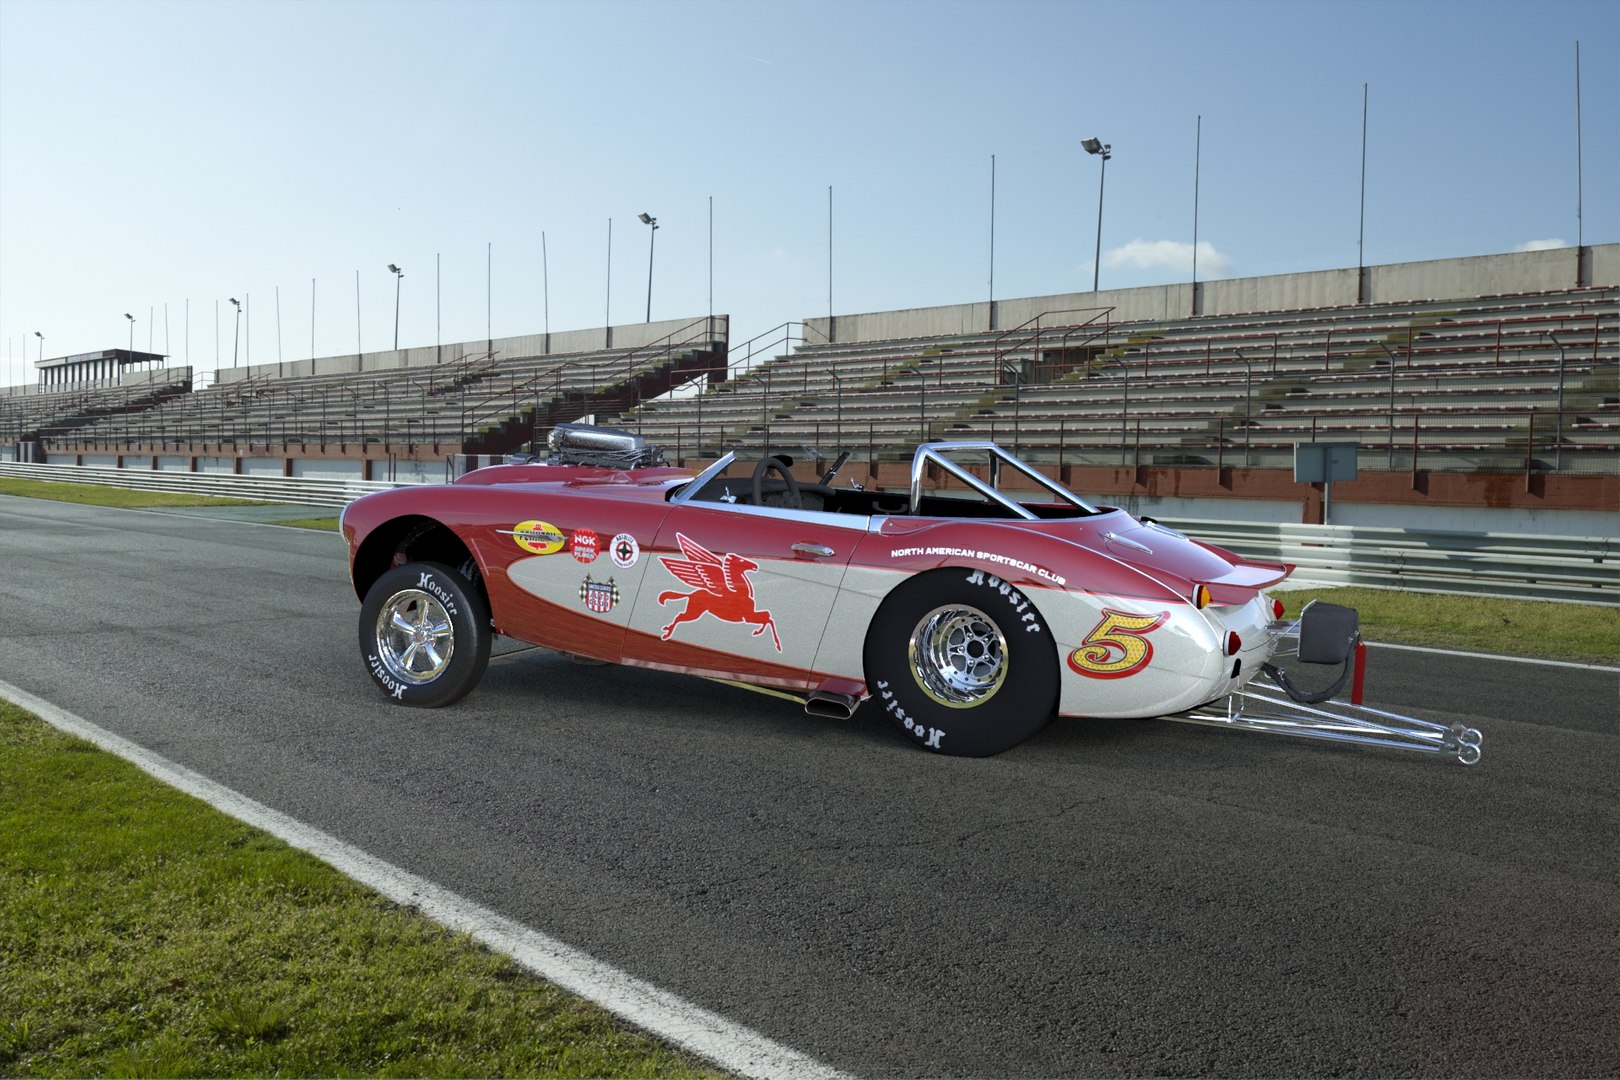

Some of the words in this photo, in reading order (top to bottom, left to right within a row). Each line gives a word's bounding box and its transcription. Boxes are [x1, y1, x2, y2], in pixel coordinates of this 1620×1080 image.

[574, 534, 596, 546] NGK
[616, 534, 634, 543] AUTOLITE
[891, 547, 924, 558] NORTH
[925, 547, 975, 558] AMERICAN
[976, 551, 1037, 574] SPORTSCAR
[1038, 568, 1067, 585] CLUB
[416, 572, 458, 615] Hoosier
[589, 599, 609, 607] CLUB
[590, 592, 609, 601] AUTO
[966, 569, 1041, 633] Hoosier
[1067, 607, 1171, 680] 5
[368, 654, 408, 700] Hoosier
[877, 680, 946, 749] Hoosier
